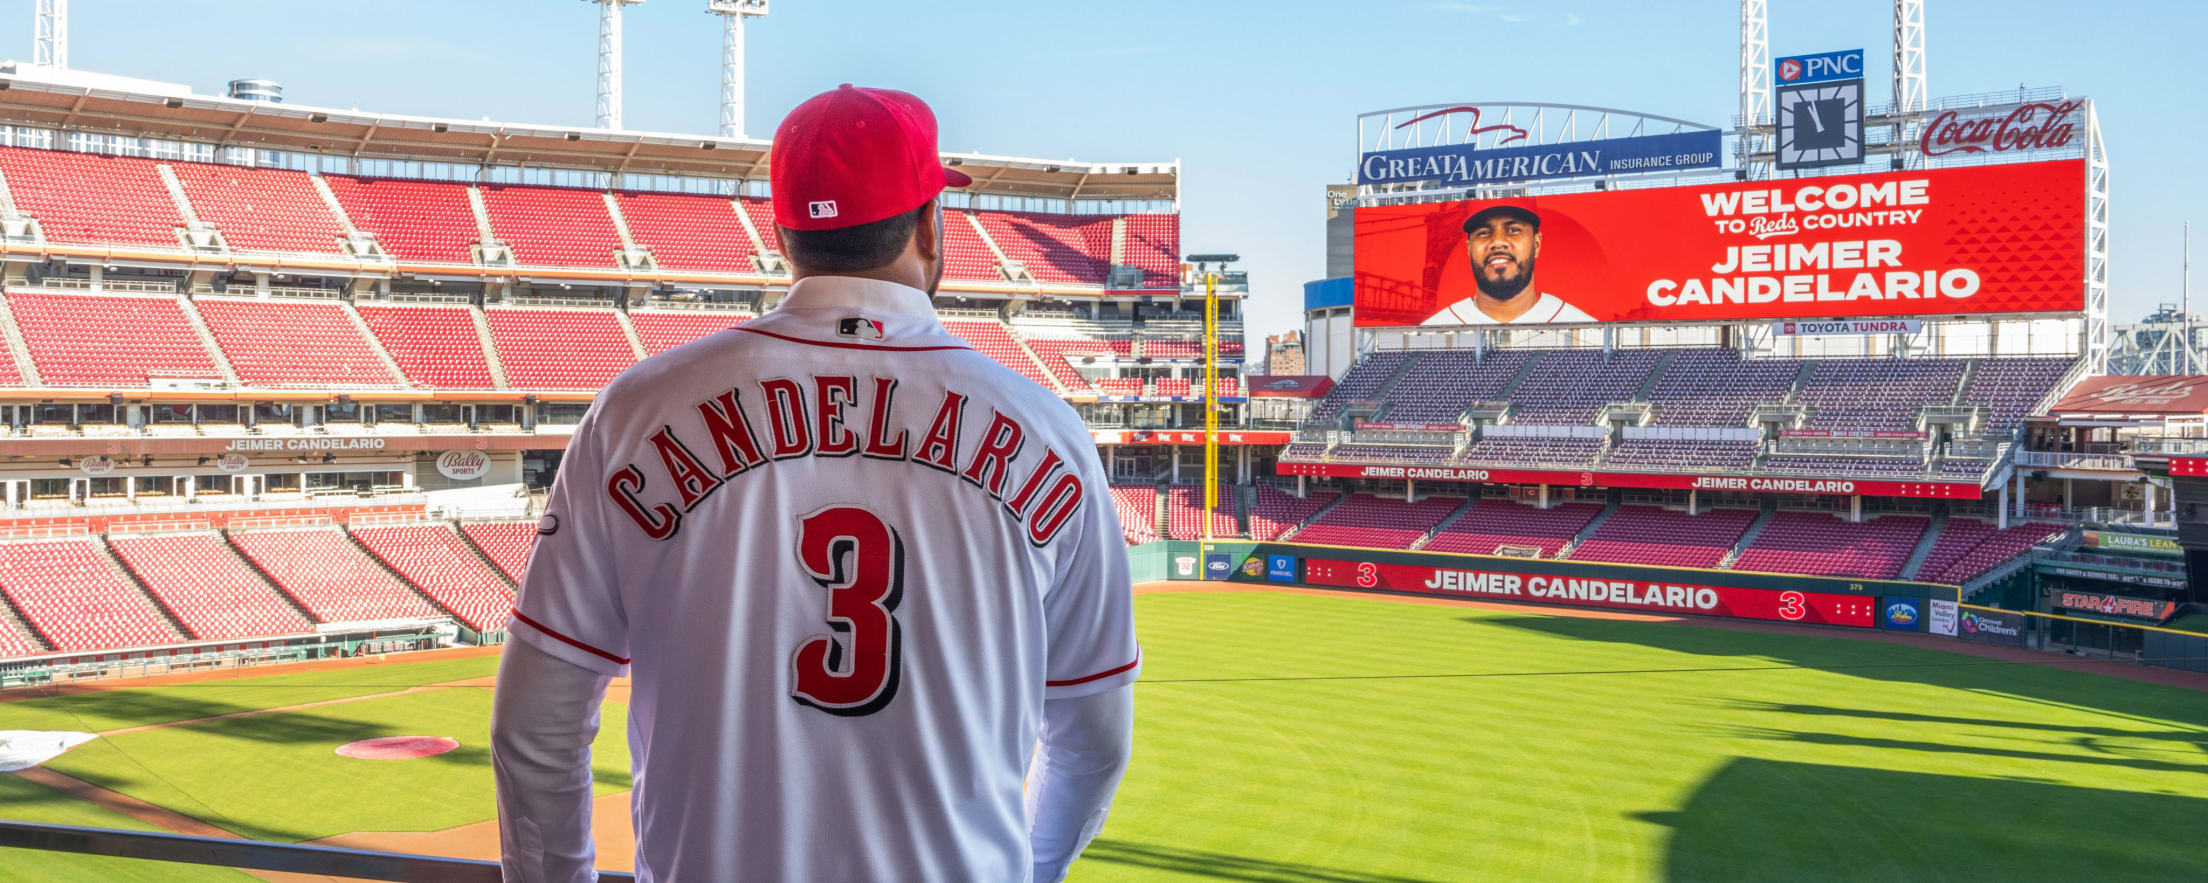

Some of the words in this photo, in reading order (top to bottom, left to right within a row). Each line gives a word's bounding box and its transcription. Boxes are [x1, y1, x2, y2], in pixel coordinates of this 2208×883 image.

[1803, 53, 1860, 77] PNC
[1920, 99, 2085, 156] Coca-Cola
[1363, 154, 1457, 181] GREAT
[1448, 150, 1601, 182] AMERICAN
[1610, 156, 1672, 171] INSURANCE
[1675, 152, 1713, 166] GROUP
[1327, 190, 1347, 198] One
[1701, 179, 1929, 217] WELCOME
[1714, 219, 1746, 234] TO
[1749, 212, 1799, 240] Reds
[1803, 209, 1923, 230] COUNTRY
[1711, 239, 1903, 274] JEIMER
[1646, 268, 1981, 307] CANDELARIO
[1800, 322, 1850, 333] TOYOTA
[1852, 321, 1908, 332] TUNDRA
[225, 438, 284, 451] JEIMER
[287, 438, 385, 451] CANDELARIO
[220, 453, 246, 466] Bally
[442, 452, 485, 468] Bally
[451, 467, 475, 475] SPORTS
[607, 374, 1084, 547] CANDELARIO
[1361, 466, 1405, 478] JEIMER
[1407, 468, 1489, 480] CANDELARIO
[1581, 472, 1593, 486] 3
[1691, 476, 1748, 491] JEIMER
[1750, 478, 1854, 494] CANDELARIO
[2108, 535, 2147, 547] LAURA'S
[1357, 562, 1378, 588] 3
[1424, 570, 1522, 595] JEIMER
[1527, 575, 1718, 610] CANDELARIO
[1778, 590, 1806, 621] 3
[1849, 583, 1864, 591] 379
[791, 503, 905, 716] 3
[1931, 602, 1954, 611] Miami
[1934, 609, 1956, 619] Valley
[2063, 593, 2101, 610] STAR
[2117, 599, 2154, 617] FIRE
[1978, 623, 2018, 636] Children's
